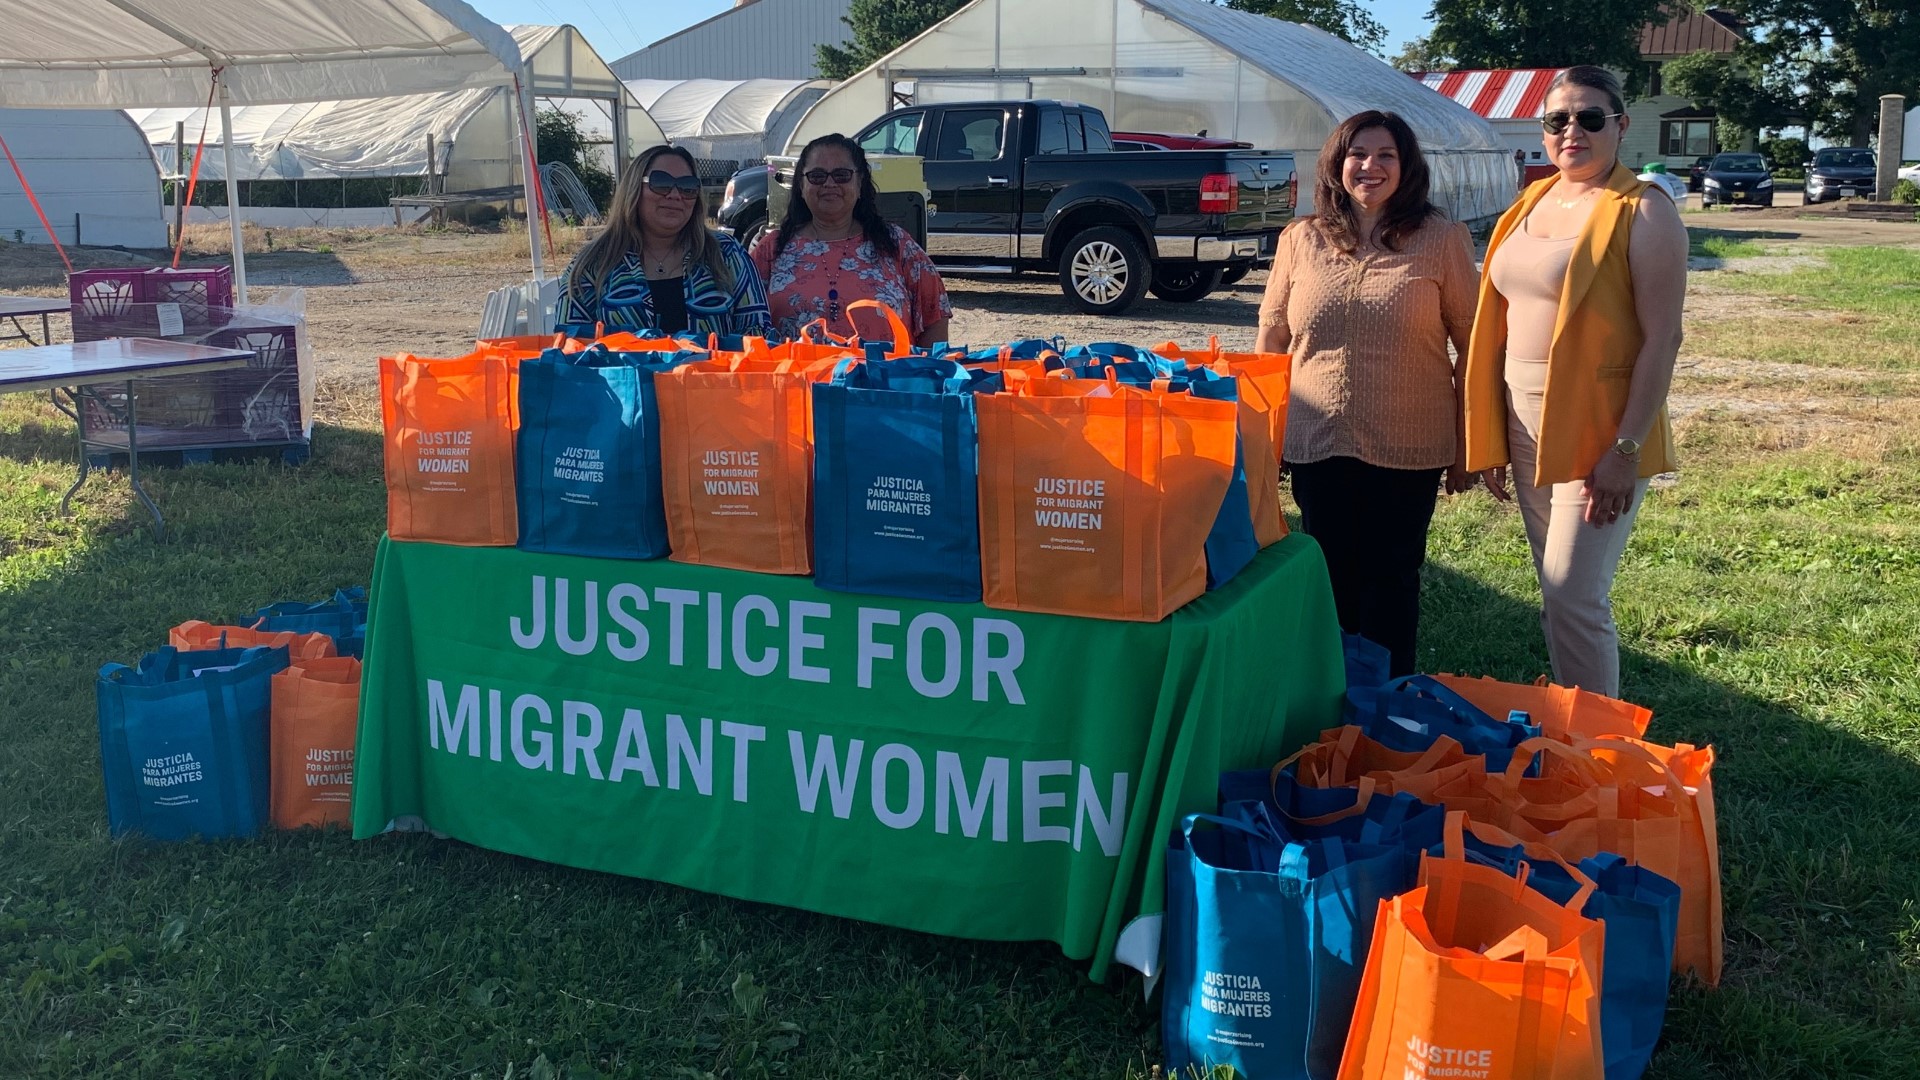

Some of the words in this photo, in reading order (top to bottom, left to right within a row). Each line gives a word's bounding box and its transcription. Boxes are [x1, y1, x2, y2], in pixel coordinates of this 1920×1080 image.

[416, 431, 472, 446] JUSTICE
[419, 448, 435, 456] FOR
[437, 448, 470, 456] MIGRANT
[562, 447, 600, 460] JUSTICIA
[702, 451, 759, 466] JUSTICE
[418, 458, 469, 473] WOMEN
[555, 457, 576, 468] PARA
[577, 460, 604, 471] MUJERES
[553, 467, 604, 483] MIGRANTES
[704, 469, 720, 477] FOR
[721, 469, 758, 478] MIGRANT
[704, 481, 760, 497] WOMEN
[873, 476, 924, 492] JUSTICIA
[1034, 478, 1105, 497] JUSTICE
[867, 488, 890, 500] PARA
[891, 491, 931, 503] MUJERES
[1036, 497, 1055, 507] FOR
[1057, 498, 1103, 510] MIGRANT
[866, 499, 931, 516] MIGRANTES
[1035, 510, 1102, 530] WOMEN
[509, 574, 831, 684] JUSTICE
[856, 606, 1027, 706] FOR
[145, 752, 194, 769] JUSTICIA
[306, 748, 354, 762] JUSTIC
[143, 767, 161, 777] PARA
[161, 761, 201, 776] MUJERES
[306, 763, 322, 771] FOR
[323, 763, 352, 771] MIGRA
[426, 678, 766, 804] MIGRANT
[787, 729, 1129, 858] WOMEN
[144, 771, 203, 787] MIGRANTES
[305, 772, 353, 786] WOME
[1204, 970, 1261, 989] JUSTICIA
[1201, 981, 1220, 998] PARA
[1220, 988, 1271, 1002] MUJERES
[1201, 993, 1272, 1018] MIGRANTES
[1406, 1034, 1492, 1067] JUSTICE
[1407, 1052, 1426, 1072] FOR
[1428, 1066, 1489, 1079] MIGRANT
